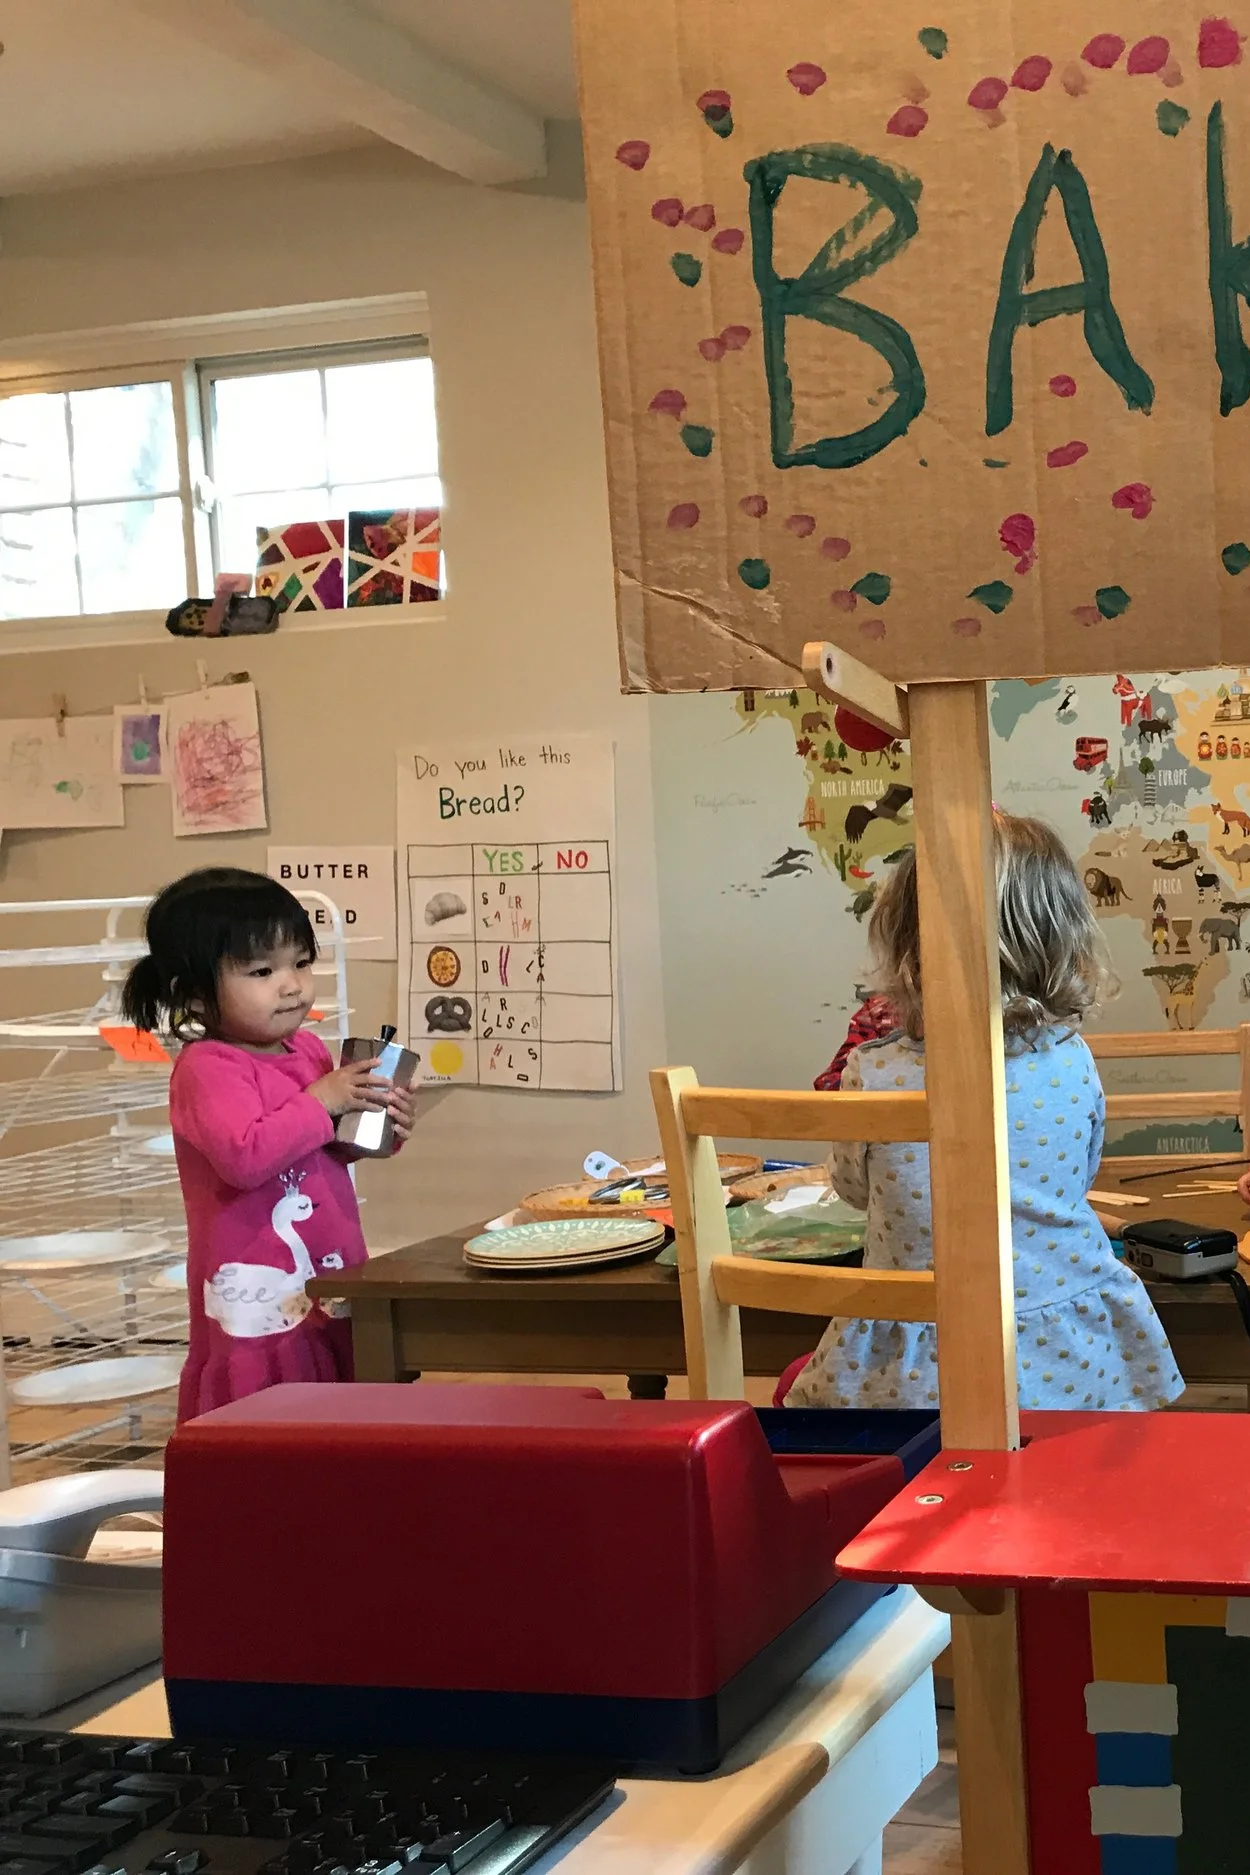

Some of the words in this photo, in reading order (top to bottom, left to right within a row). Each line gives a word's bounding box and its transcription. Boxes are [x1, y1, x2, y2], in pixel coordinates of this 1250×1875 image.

[414, 755, 439, 780] Do
[454, 760, 487, 780] you
[499, 748, 527, 768] like
[539, 745, 571, 765] this
[1158, 768, 1188, 787] EUROPE
[820, 780, 848, 798] NORTH
[850, 778, 885, 797] AMERICA
[439, 784, 525, 819] Bread?
[482, 848, 525, 872] YES
[556, 849, 589, 869] NO
[280, 864, 369, 879] BUTTER
[1152, 878, 1183, 895] AFRICA
[1155, 1136, 1211, 1154] ANTARCTICA
